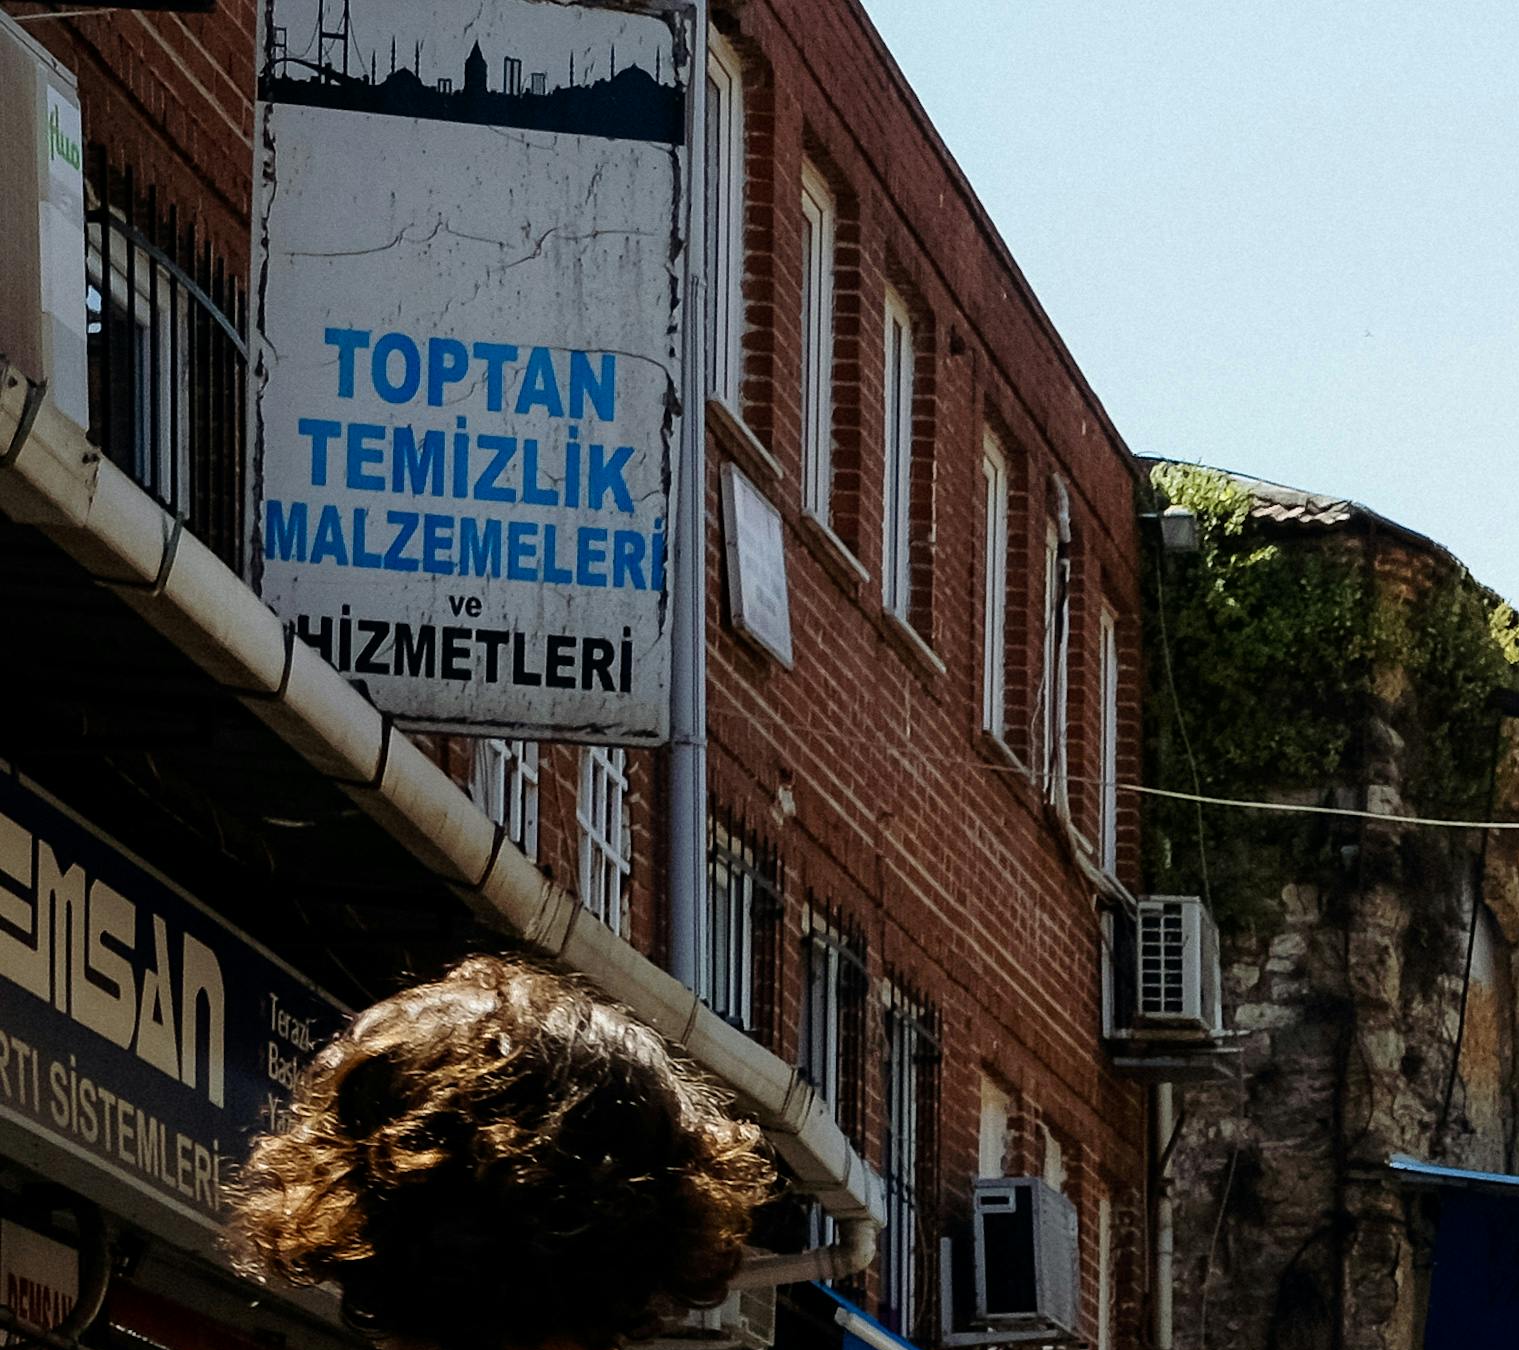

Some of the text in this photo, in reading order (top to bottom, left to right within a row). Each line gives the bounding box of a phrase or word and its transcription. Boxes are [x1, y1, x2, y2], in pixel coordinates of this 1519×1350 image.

[325, 327, 615, 422] TOPTAN
[298, 416, 635, 513] TEMİZLİK
[265, 500, 666, 592] MALZEMELERİ
[296, 604, 632, 693] HİZMETLERİ
[449, 595, 482, 617] ve
[49, 1054, 221, 1212] SİSTEMLERİ
